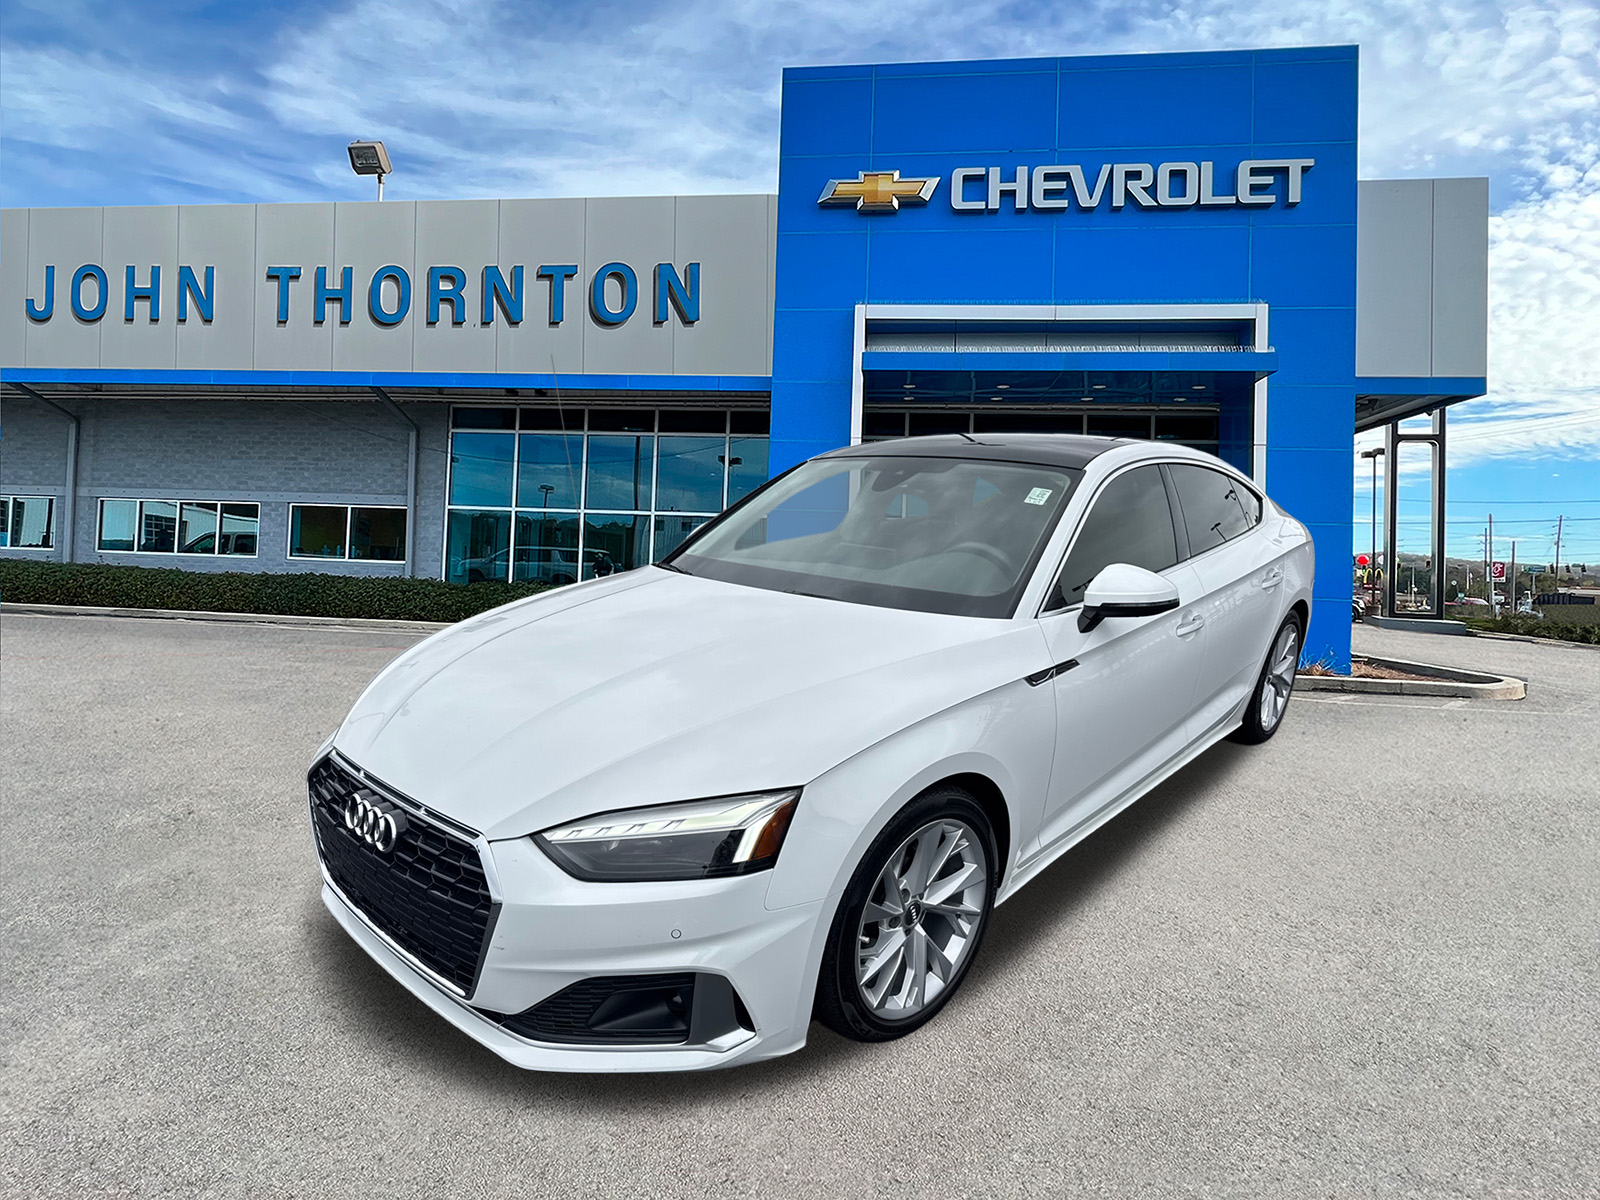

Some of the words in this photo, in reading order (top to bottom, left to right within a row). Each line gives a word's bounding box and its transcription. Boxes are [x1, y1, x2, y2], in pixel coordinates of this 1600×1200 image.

[950, 158, 1315, 211] CHEVROLET
[25, 263, 215, 322] JOHN
[266, 261, 701, 326] THORNTON
